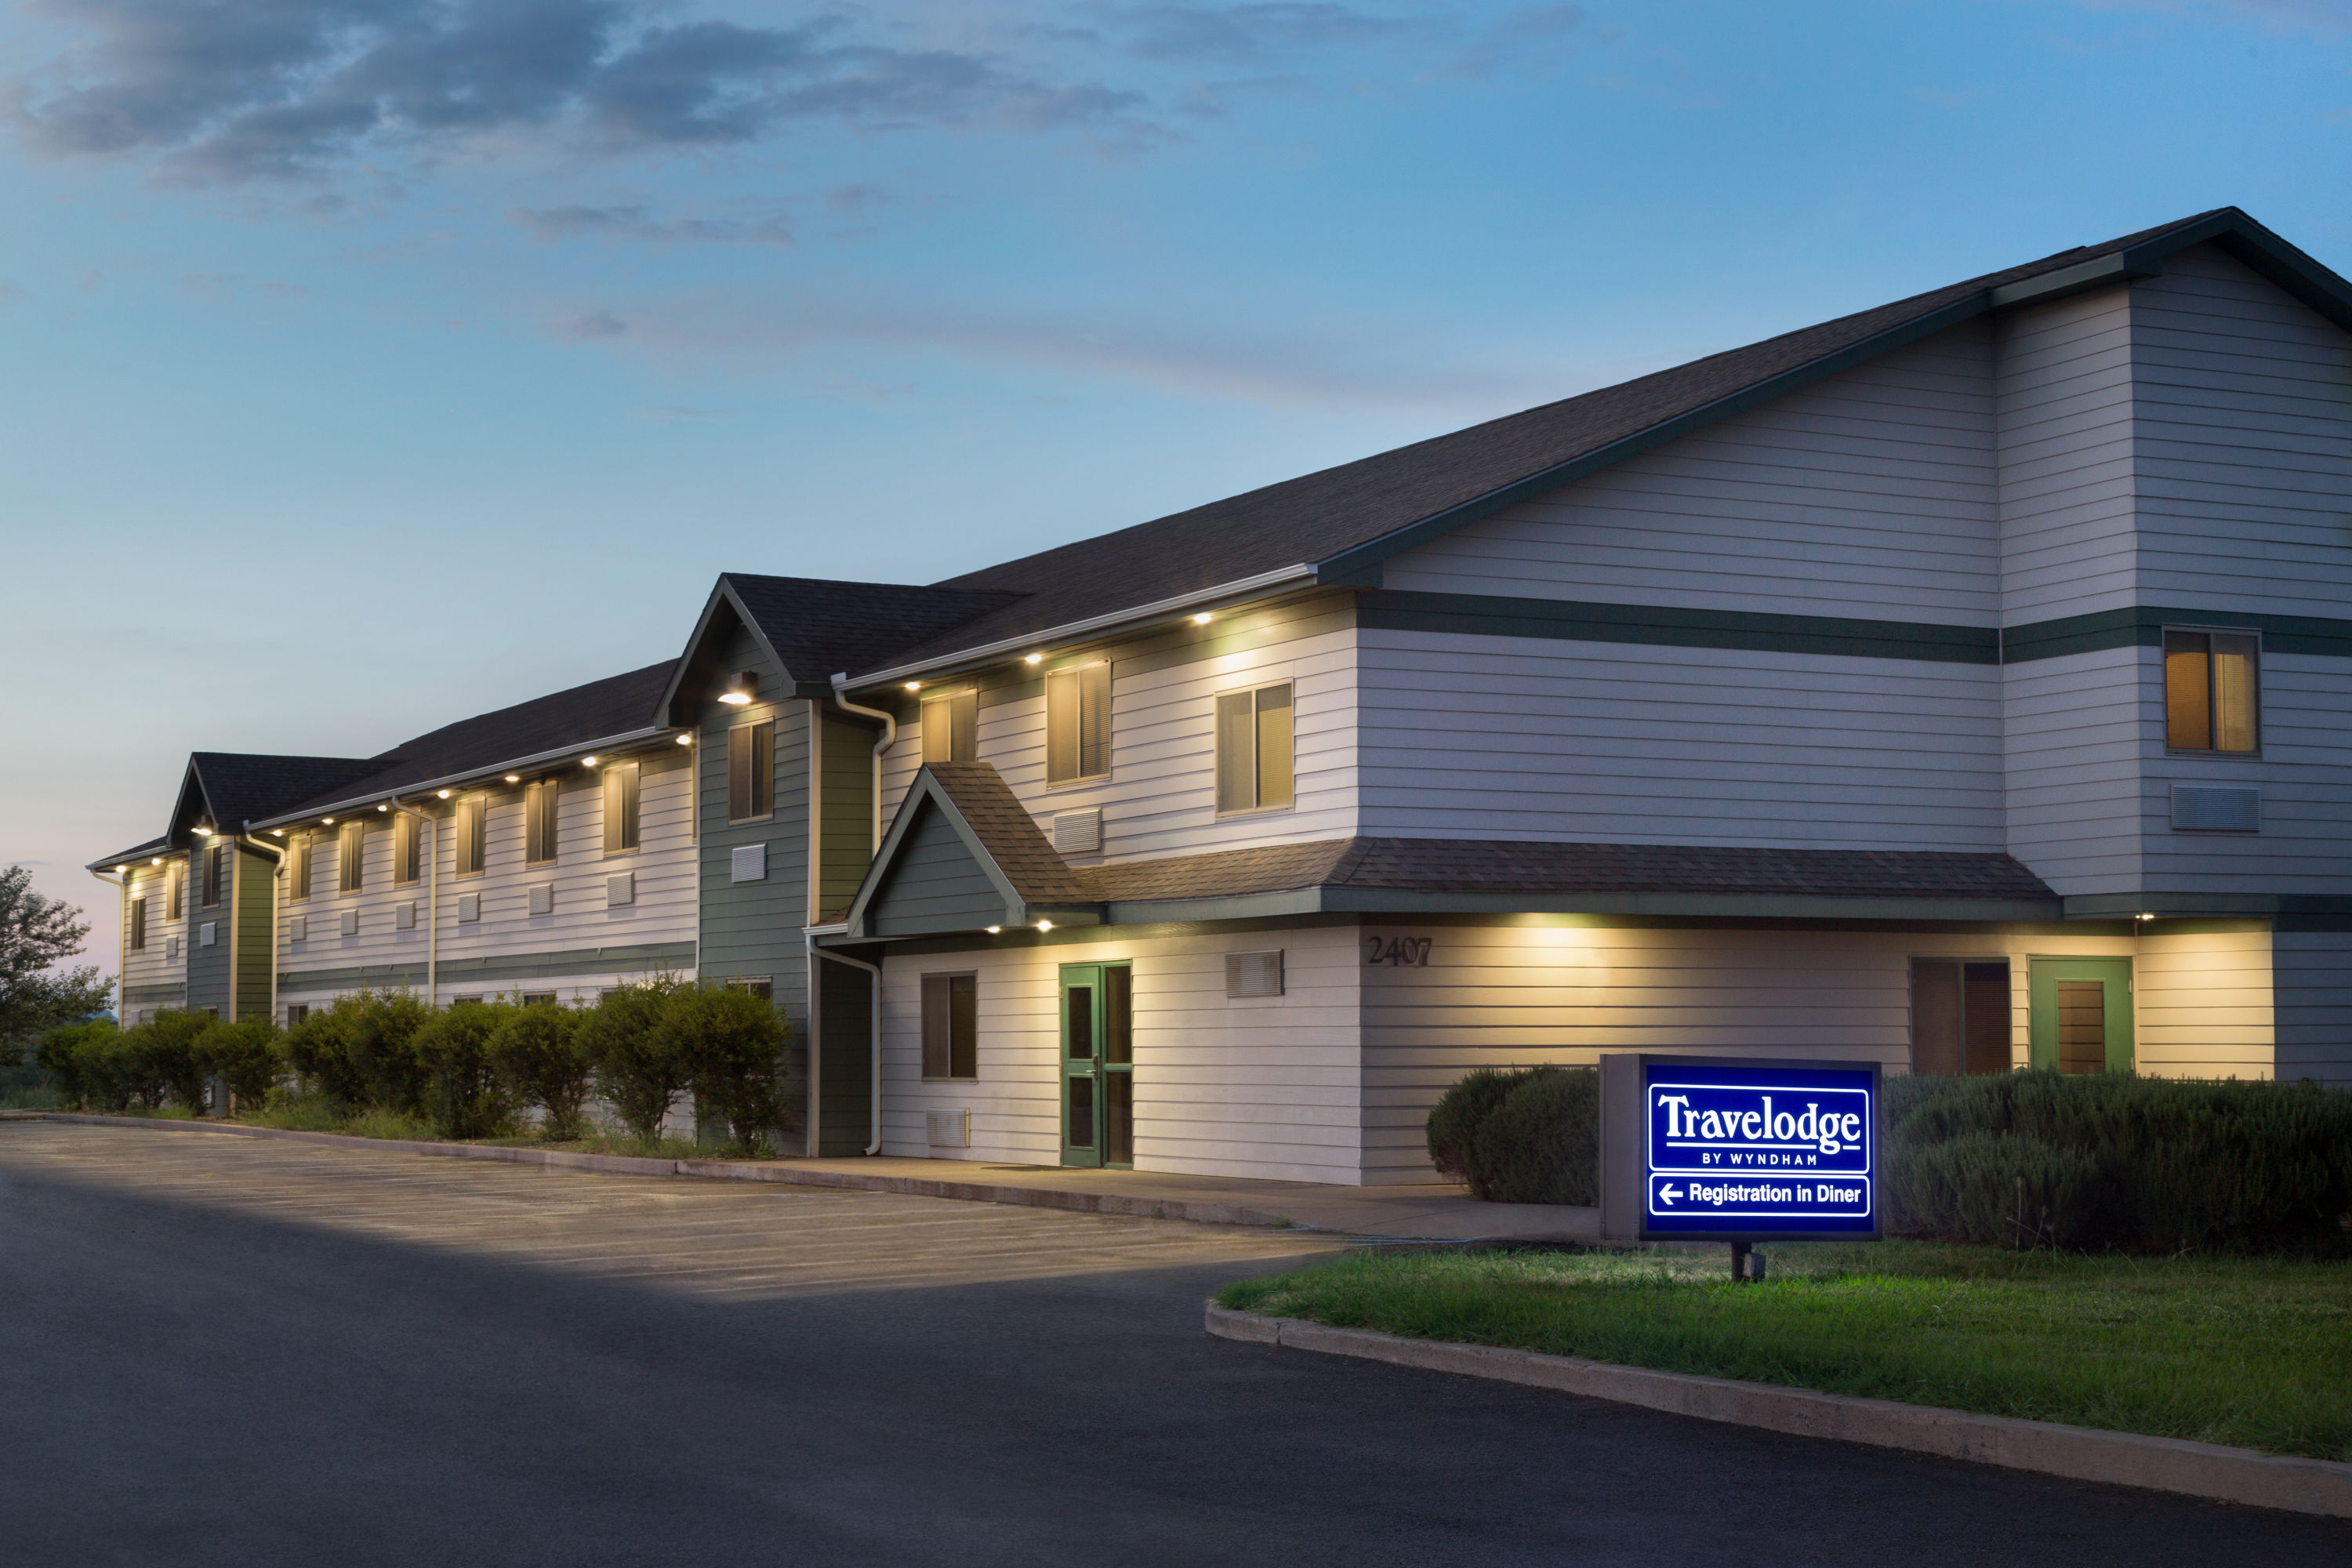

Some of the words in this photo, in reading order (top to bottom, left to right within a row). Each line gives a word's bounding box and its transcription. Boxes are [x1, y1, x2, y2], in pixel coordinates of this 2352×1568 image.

[1367, 936, 1432, 967] 2407
[1657, 1094, 1861, 1155] Travelodge
[1702, 1152, 1722, 1164] BY
[1730, 1153, 1817, 1166] WYNDHAM
[1690, 1182, 1792, 1206] Registration
[1797, 1184, 1812, 1203] in
[1817, 1185, 1861, 1203] Diner
